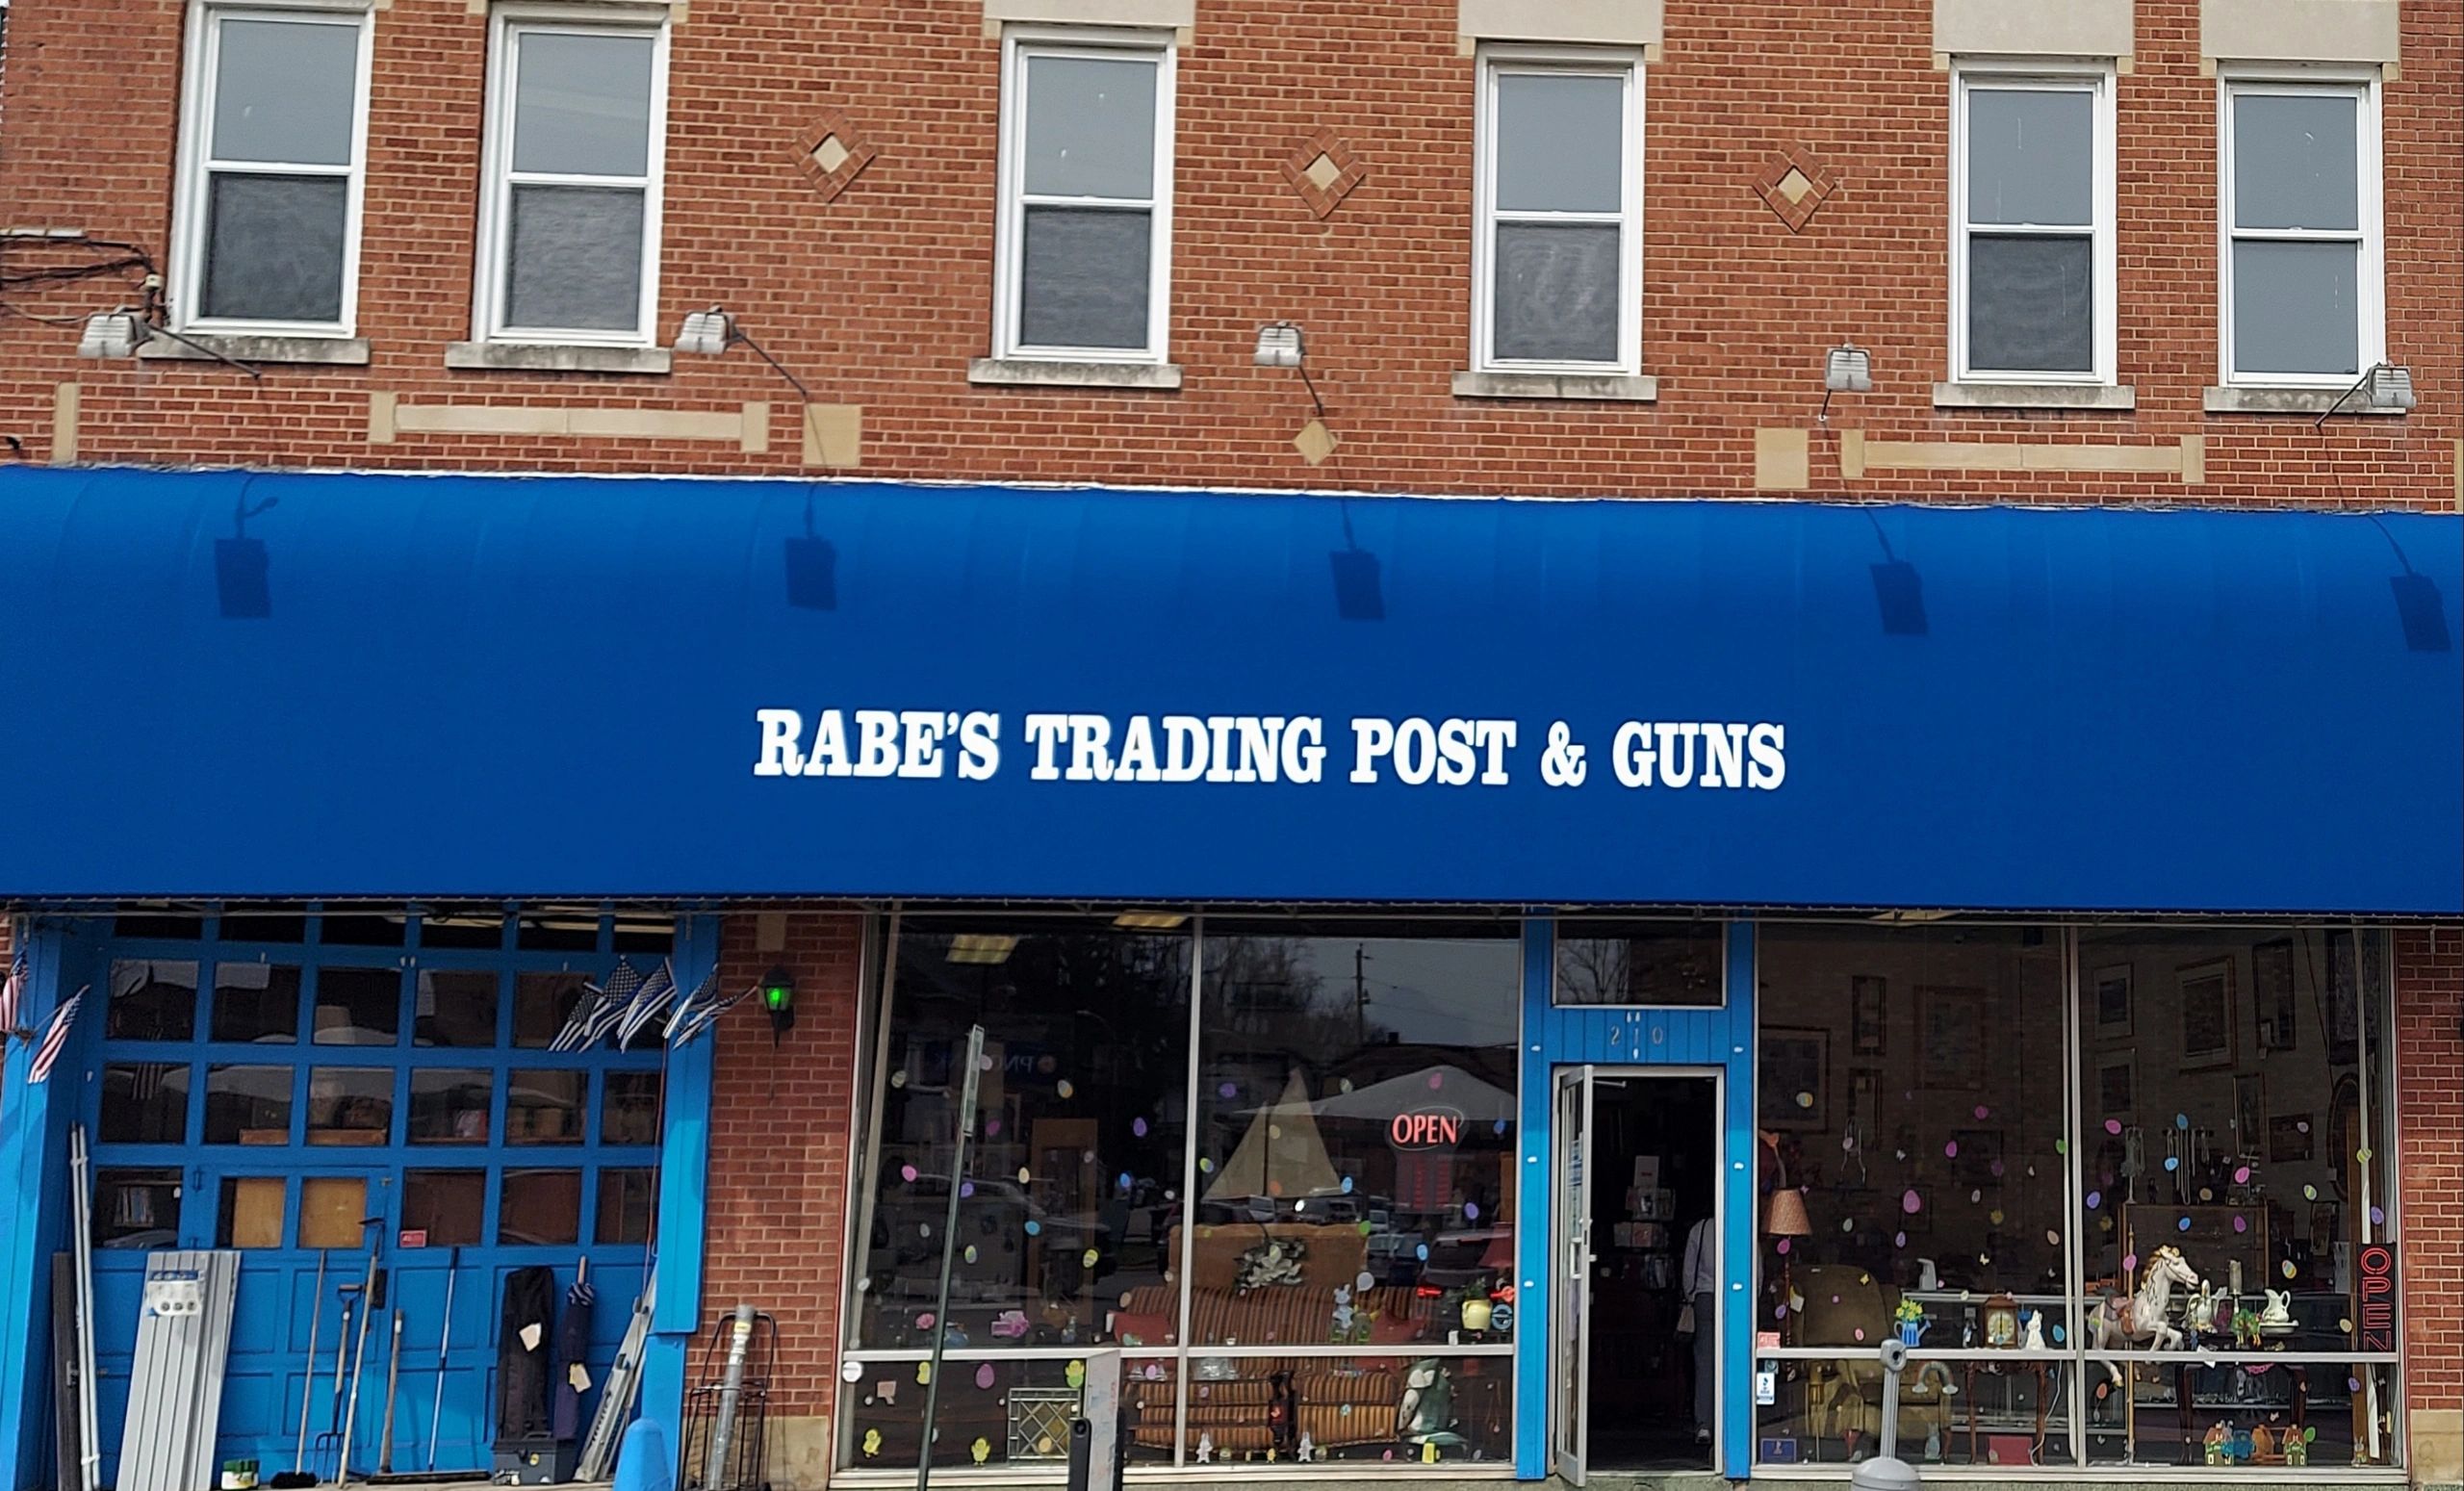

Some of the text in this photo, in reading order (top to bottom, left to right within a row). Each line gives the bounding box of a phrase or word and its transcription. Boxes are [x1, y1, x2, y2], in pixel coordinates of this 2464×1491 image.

[755, 708, 1787, 791] RABE'S TRADING POST & GUNS
[1392, 1114, 1457, 1144] OPEN
[2360, 1247, 2392, 1351] OPEN
